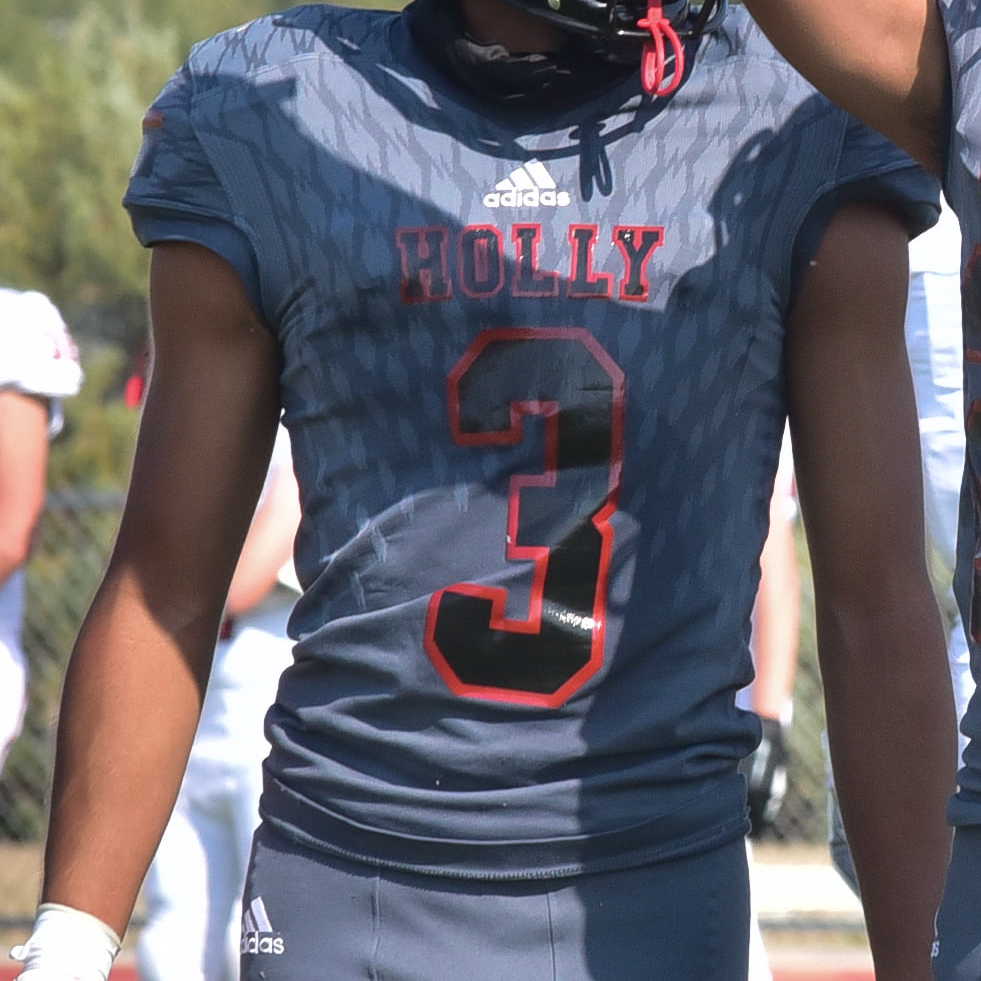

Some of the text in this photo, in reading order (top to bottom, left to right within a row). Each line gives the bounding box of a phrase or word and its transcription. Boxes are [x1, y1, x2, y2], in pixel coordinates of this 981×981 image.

[483, 185, 571, 208] adidas
[396, 222, 665, 303] HOLLY
[423, 326, 626, 708] 3
